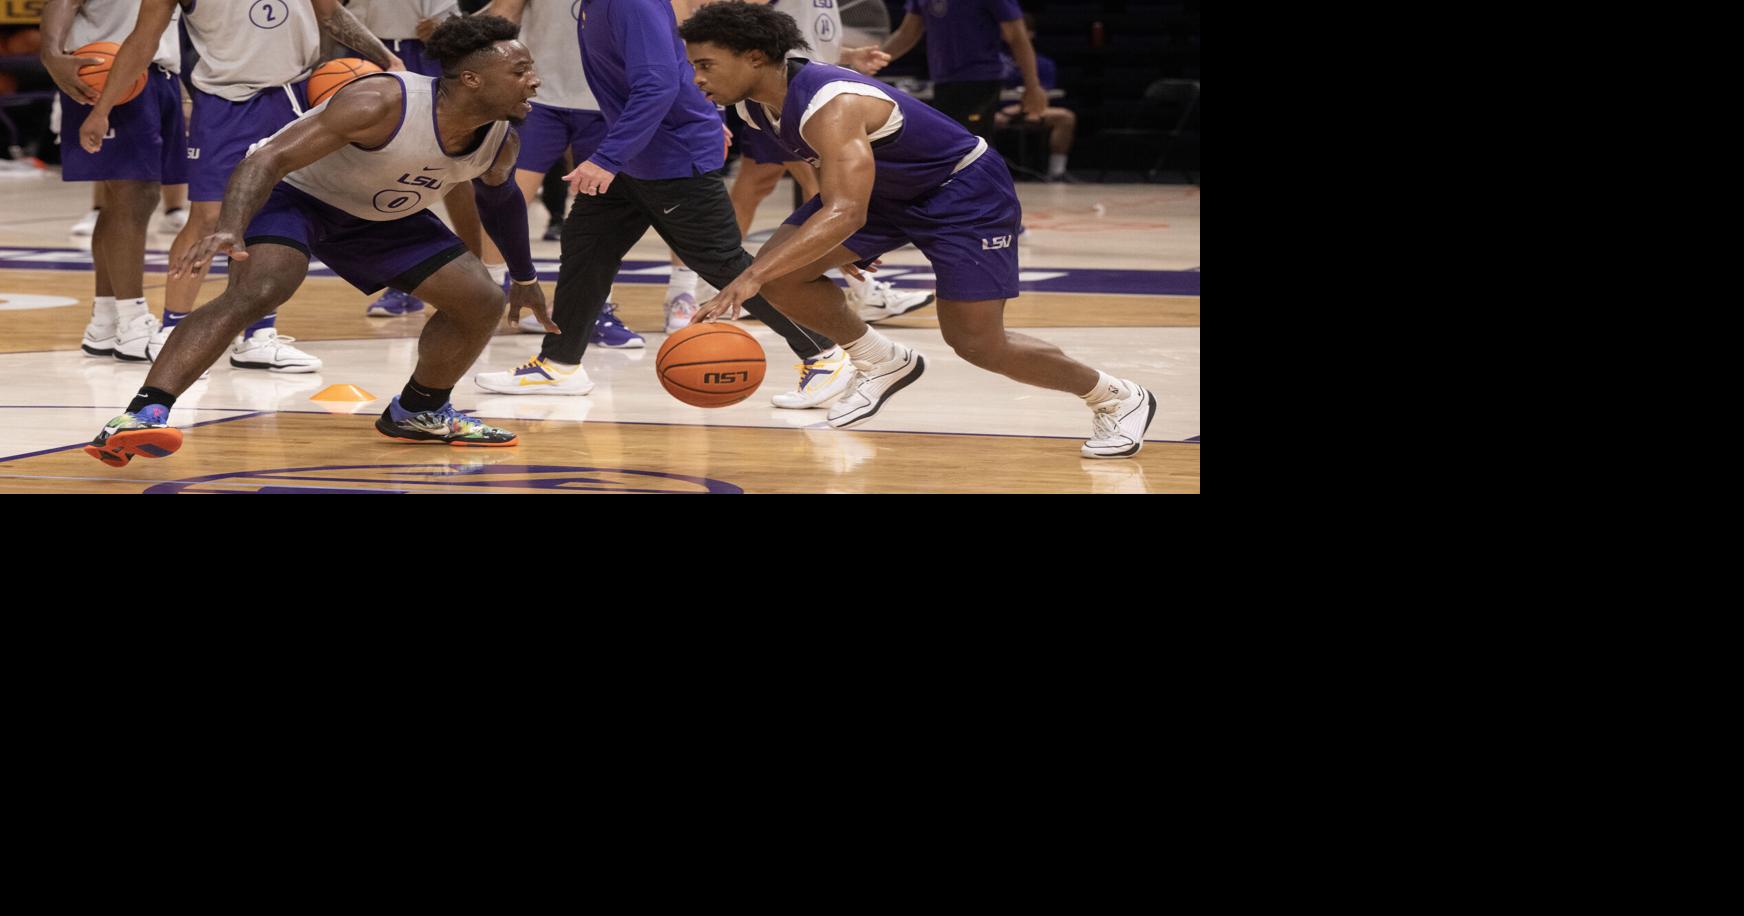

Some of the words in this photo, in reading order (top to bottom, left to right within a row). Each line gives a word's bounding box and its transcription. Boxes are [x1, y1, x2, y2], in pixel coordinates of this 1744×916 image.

[263, 4, 276, 22] 2
[187, 147, 200, 160] SU
[397, 173, 443, 190] LSU
[387, 196, 409, 209] 0
[982, 234, 1012, 250] LSU
[703, 370, 749, 385] LSU
